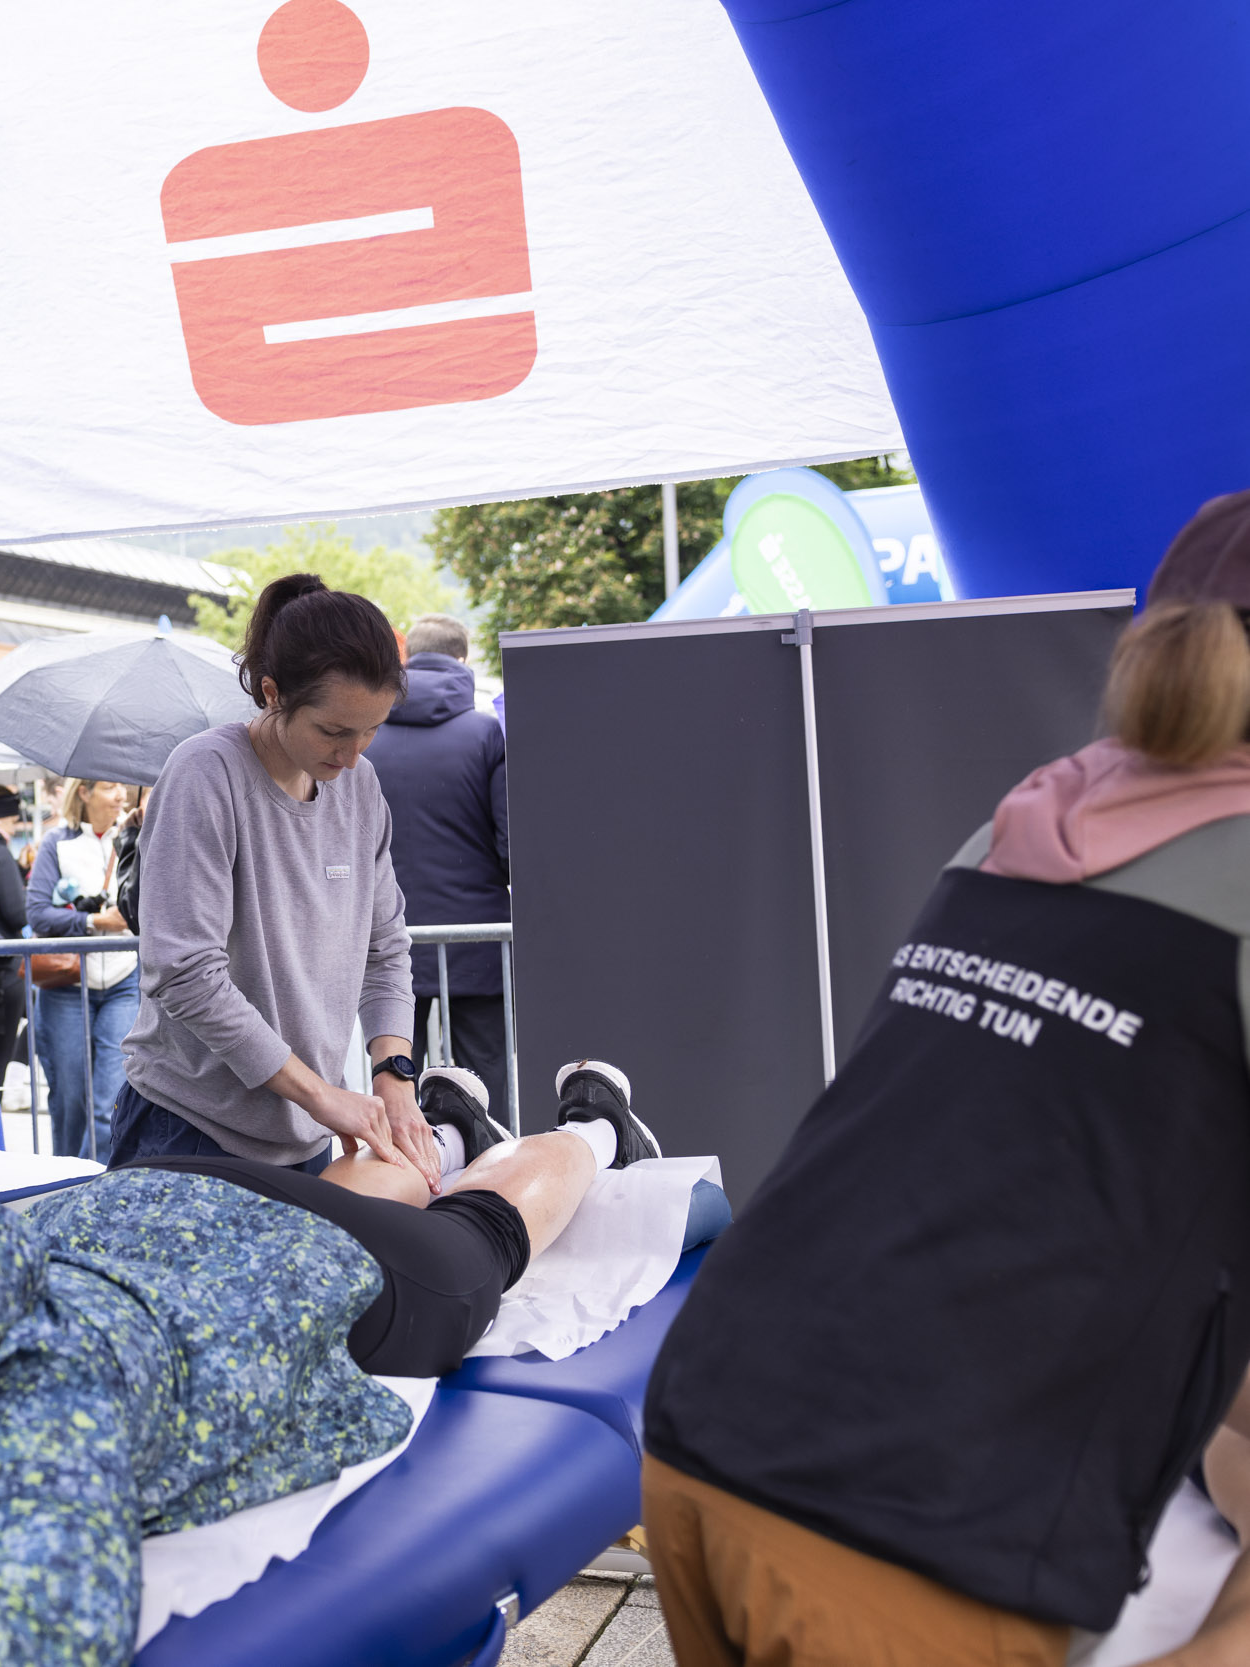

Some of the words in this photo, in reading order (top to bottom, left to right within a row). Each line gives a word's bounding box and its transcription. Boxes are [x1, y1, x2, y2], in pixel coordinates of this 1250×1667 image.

[889, 977, 977, 1021] RICHTIG
[978, 1000, 1043, 1047] TUN
[909, 943, 1144, 1047] ENTSCHEIDENDE
